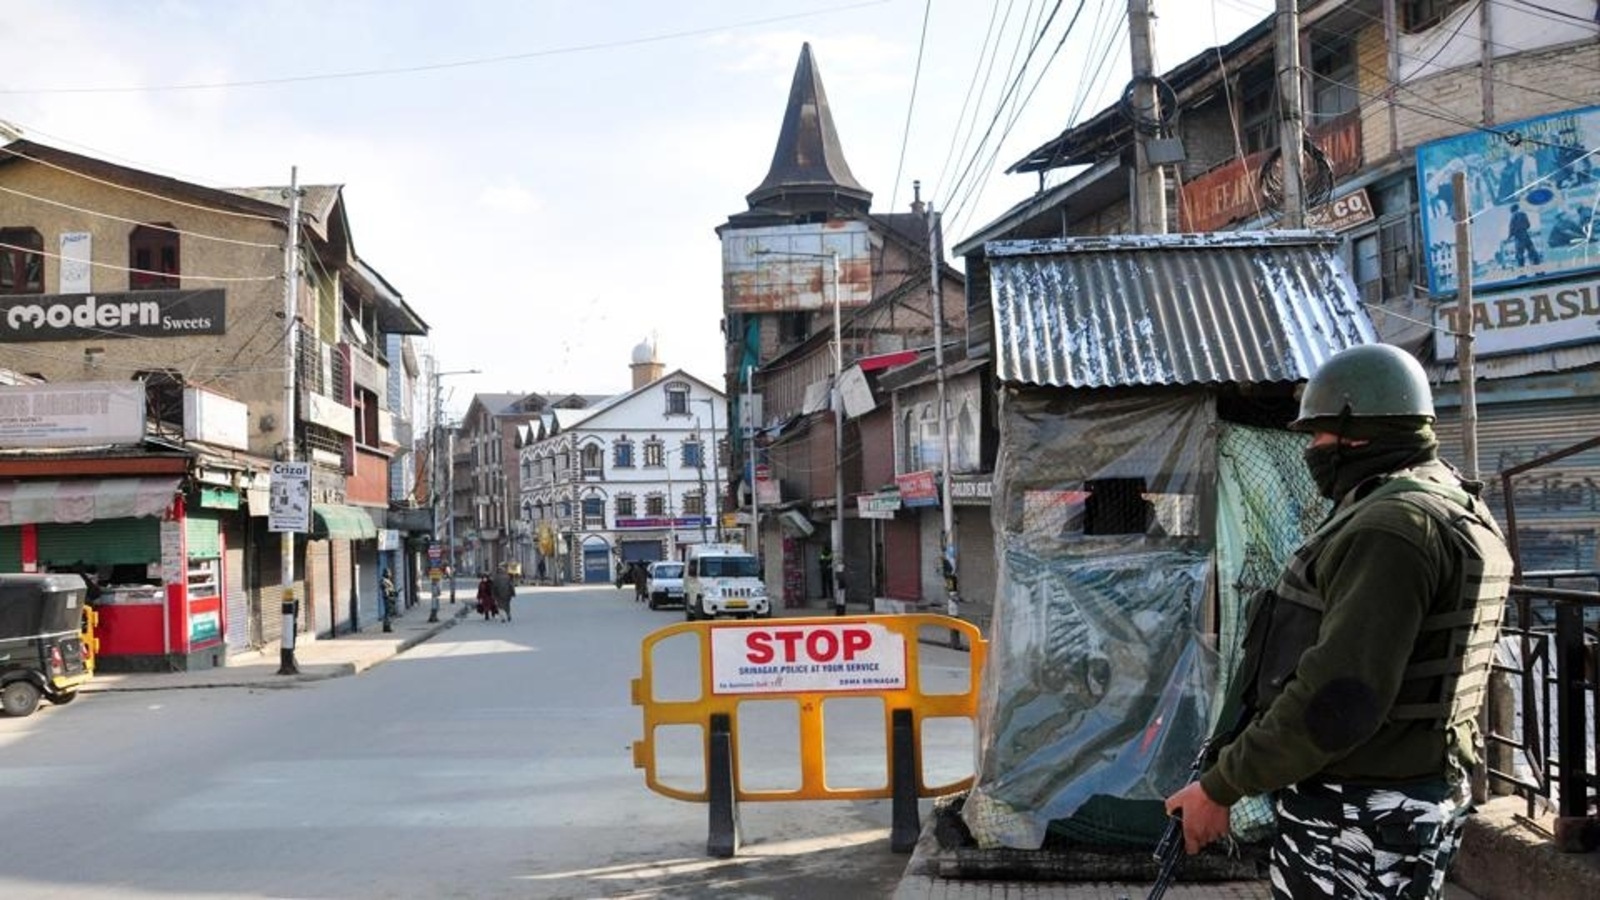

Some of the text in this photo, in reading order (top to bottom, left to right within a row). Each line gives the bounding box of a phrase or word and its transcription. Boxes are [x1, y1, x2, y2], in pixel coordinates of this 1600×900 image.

[1334, 195, 1367, 217] CO.
[162, 315, 211, 330] Sweets
[746, 629, 872, 664] STOP
[739, 663, 880, 675] SRINAGAR POLICE AT YOUR SERVICE
